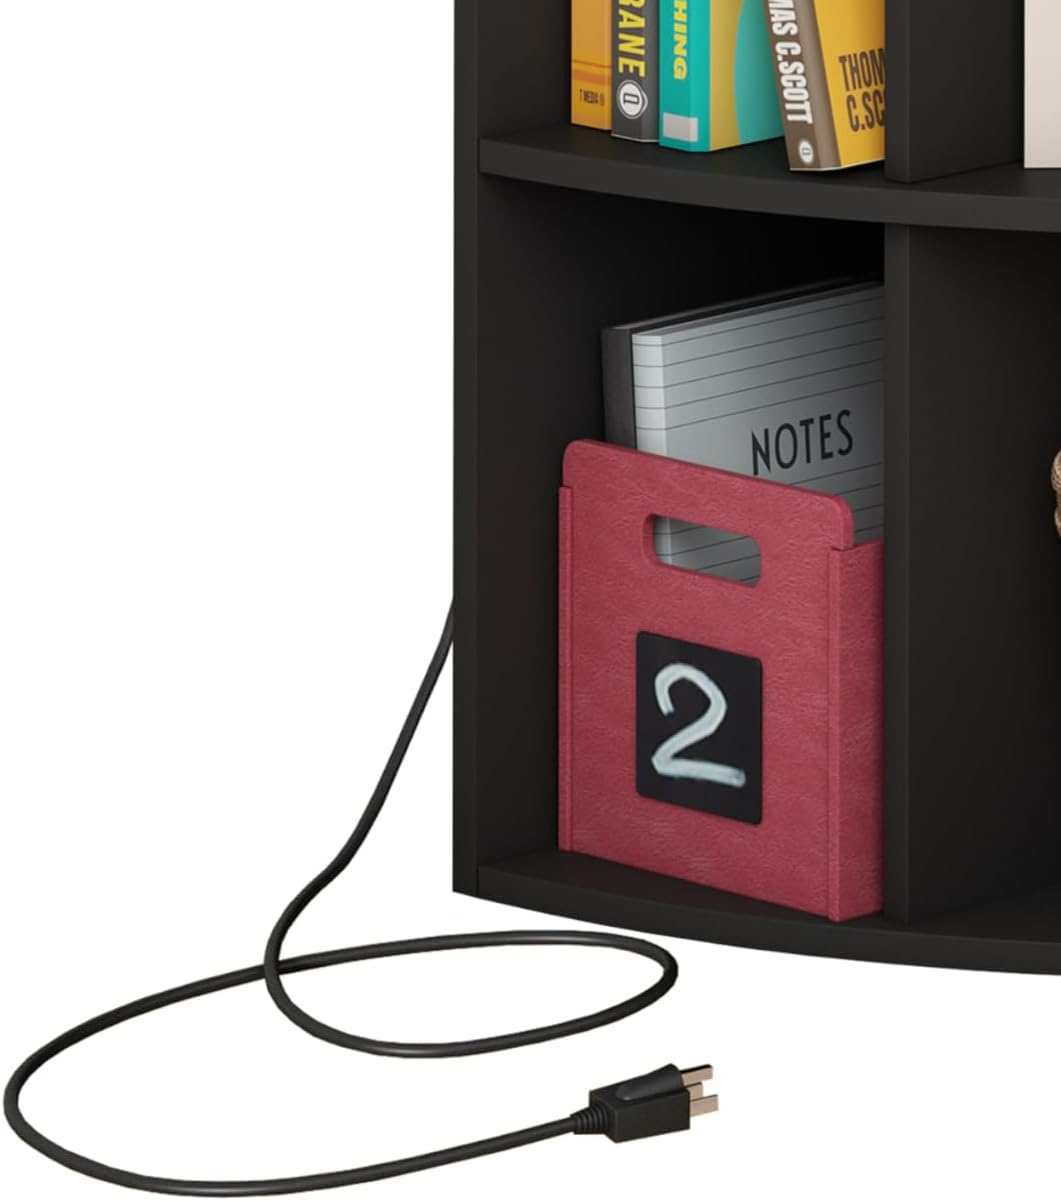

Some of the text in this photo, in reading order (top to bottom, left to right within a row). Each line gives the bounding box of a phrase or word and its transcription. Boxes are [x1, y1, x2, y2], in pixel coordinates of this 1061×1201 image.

[775, 41, 814, 124] C.SCOTT
[751, 409, 853, 476] NOTES
[651, 663, 745, 787] 2
